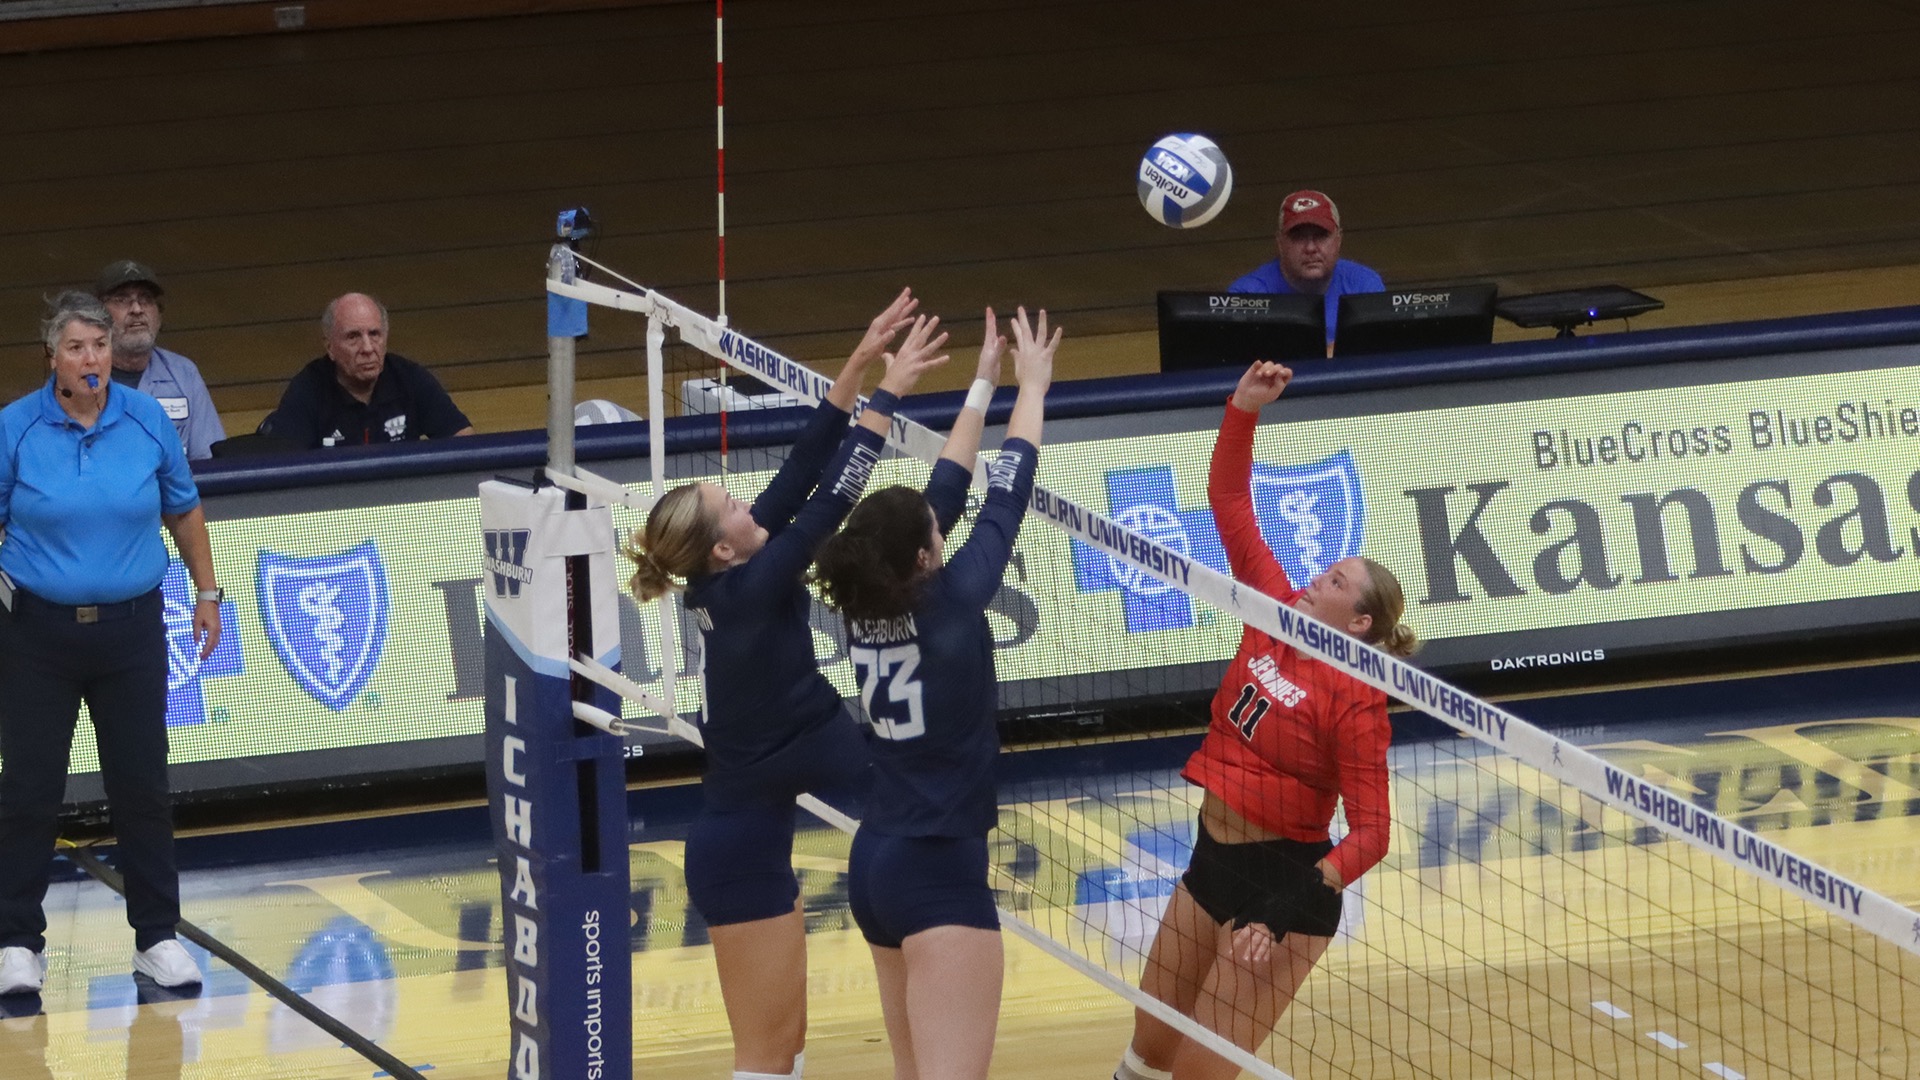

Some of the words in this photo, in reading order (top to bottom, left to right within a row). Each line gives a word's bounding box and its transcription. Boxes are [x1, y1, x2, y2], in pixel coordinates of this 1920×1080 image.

[1145, 166, 1188, 200] molten
[720, 331, 809, 395] WASHBURN
[1531, 421, 1733, 470] BlueCross
[484, 555, 533, 584] WASHBURN
[1088, 513, 1191, 586] UNIVERSITY
[1247, 654, 1307, 708] JENNIES
[1278, 606, 1386, 682] WASHBURN
[1392, 663, 1509, 741] UNIVERSITY
[1490, 649, 1605, 671] DAKTRONICS
[1228, 682, 1272, 742] 11
[1604, 766, 1726, 850] WASHBURN
[1733, 829, 1863, 915] UNIVERSITY
[582, 910, 603, 985] sports
